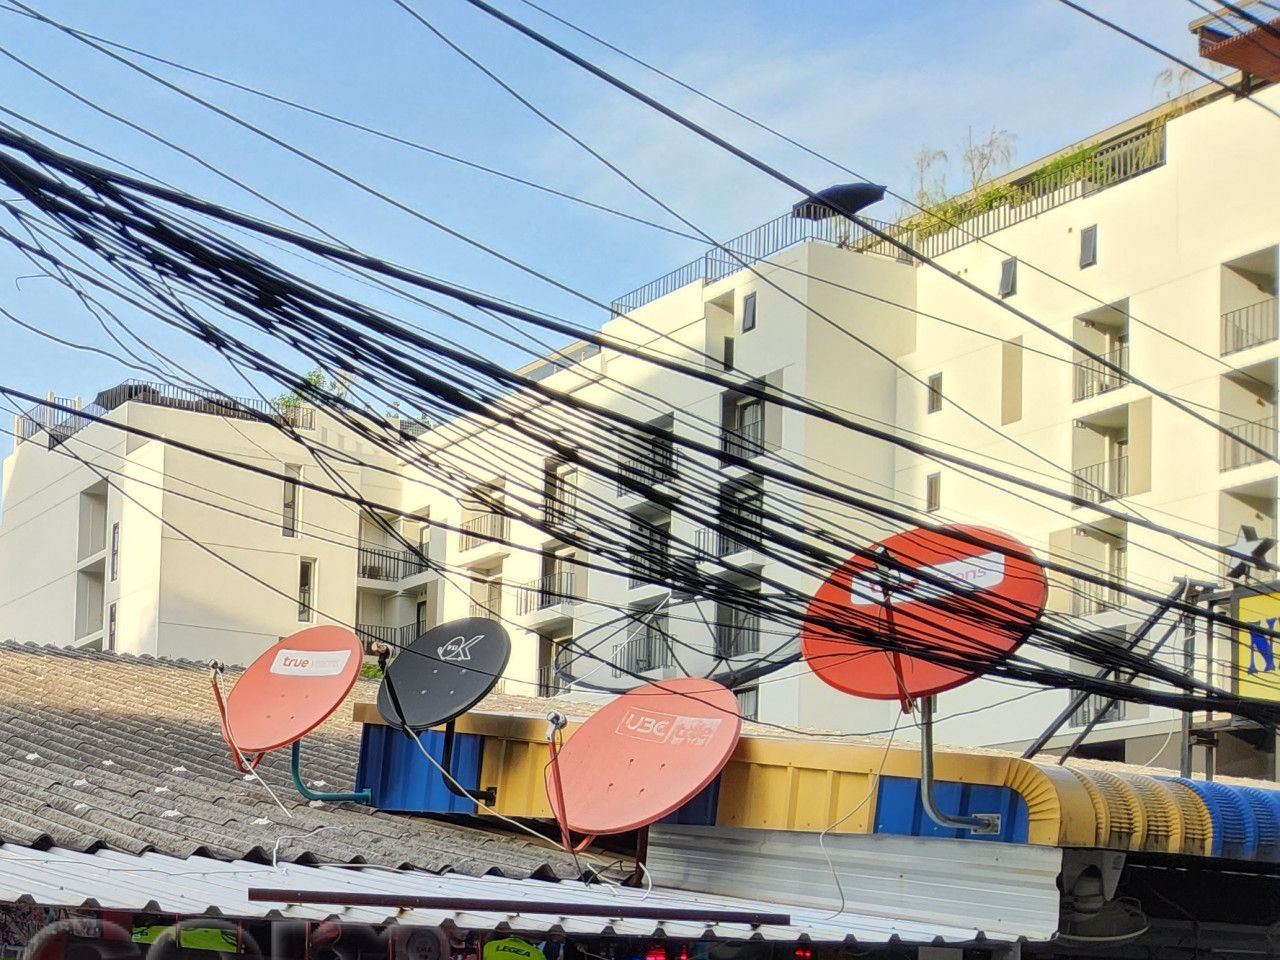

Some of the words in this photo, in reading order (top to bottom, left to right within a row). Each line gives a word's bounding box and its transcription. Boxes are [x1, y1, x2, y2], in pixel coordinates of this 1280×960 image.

[1248, 616, 1280, 675] N
[282, 655, 310, 668] true
[495, 943, 532, 959] LEGEA
